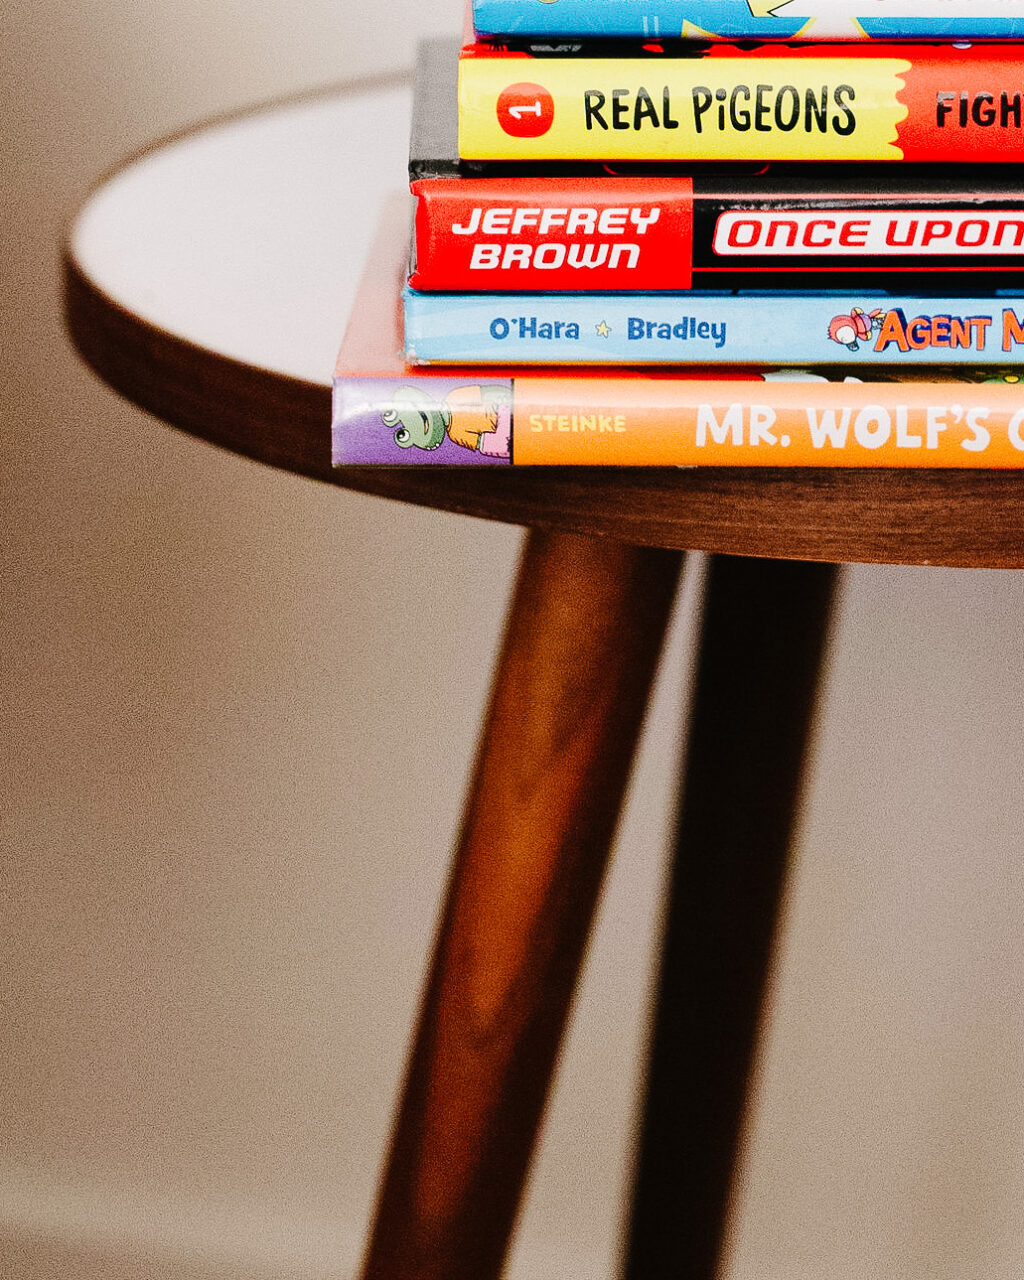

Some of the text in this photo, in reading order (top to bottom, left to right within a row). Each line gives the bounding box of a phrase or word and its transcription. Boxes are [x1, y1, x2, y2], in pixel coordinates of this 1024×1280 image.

[508, 100, 542, 120] 1
[584, 85, 679, 131] REAL
[451, 208, 661, 235] JEFFREY
[727, 219, 871, 248] ONCE
[469, 243, 641, 270] BROWN
[489, 316, 727, 348] O'Hara Bradley
[874, 308, 992, 352] AGENT
[529, 414, 626, 433] STEINKE
[695, 403, 792, 447] MR.
[806, 404, 991, 452] WOLF'S
